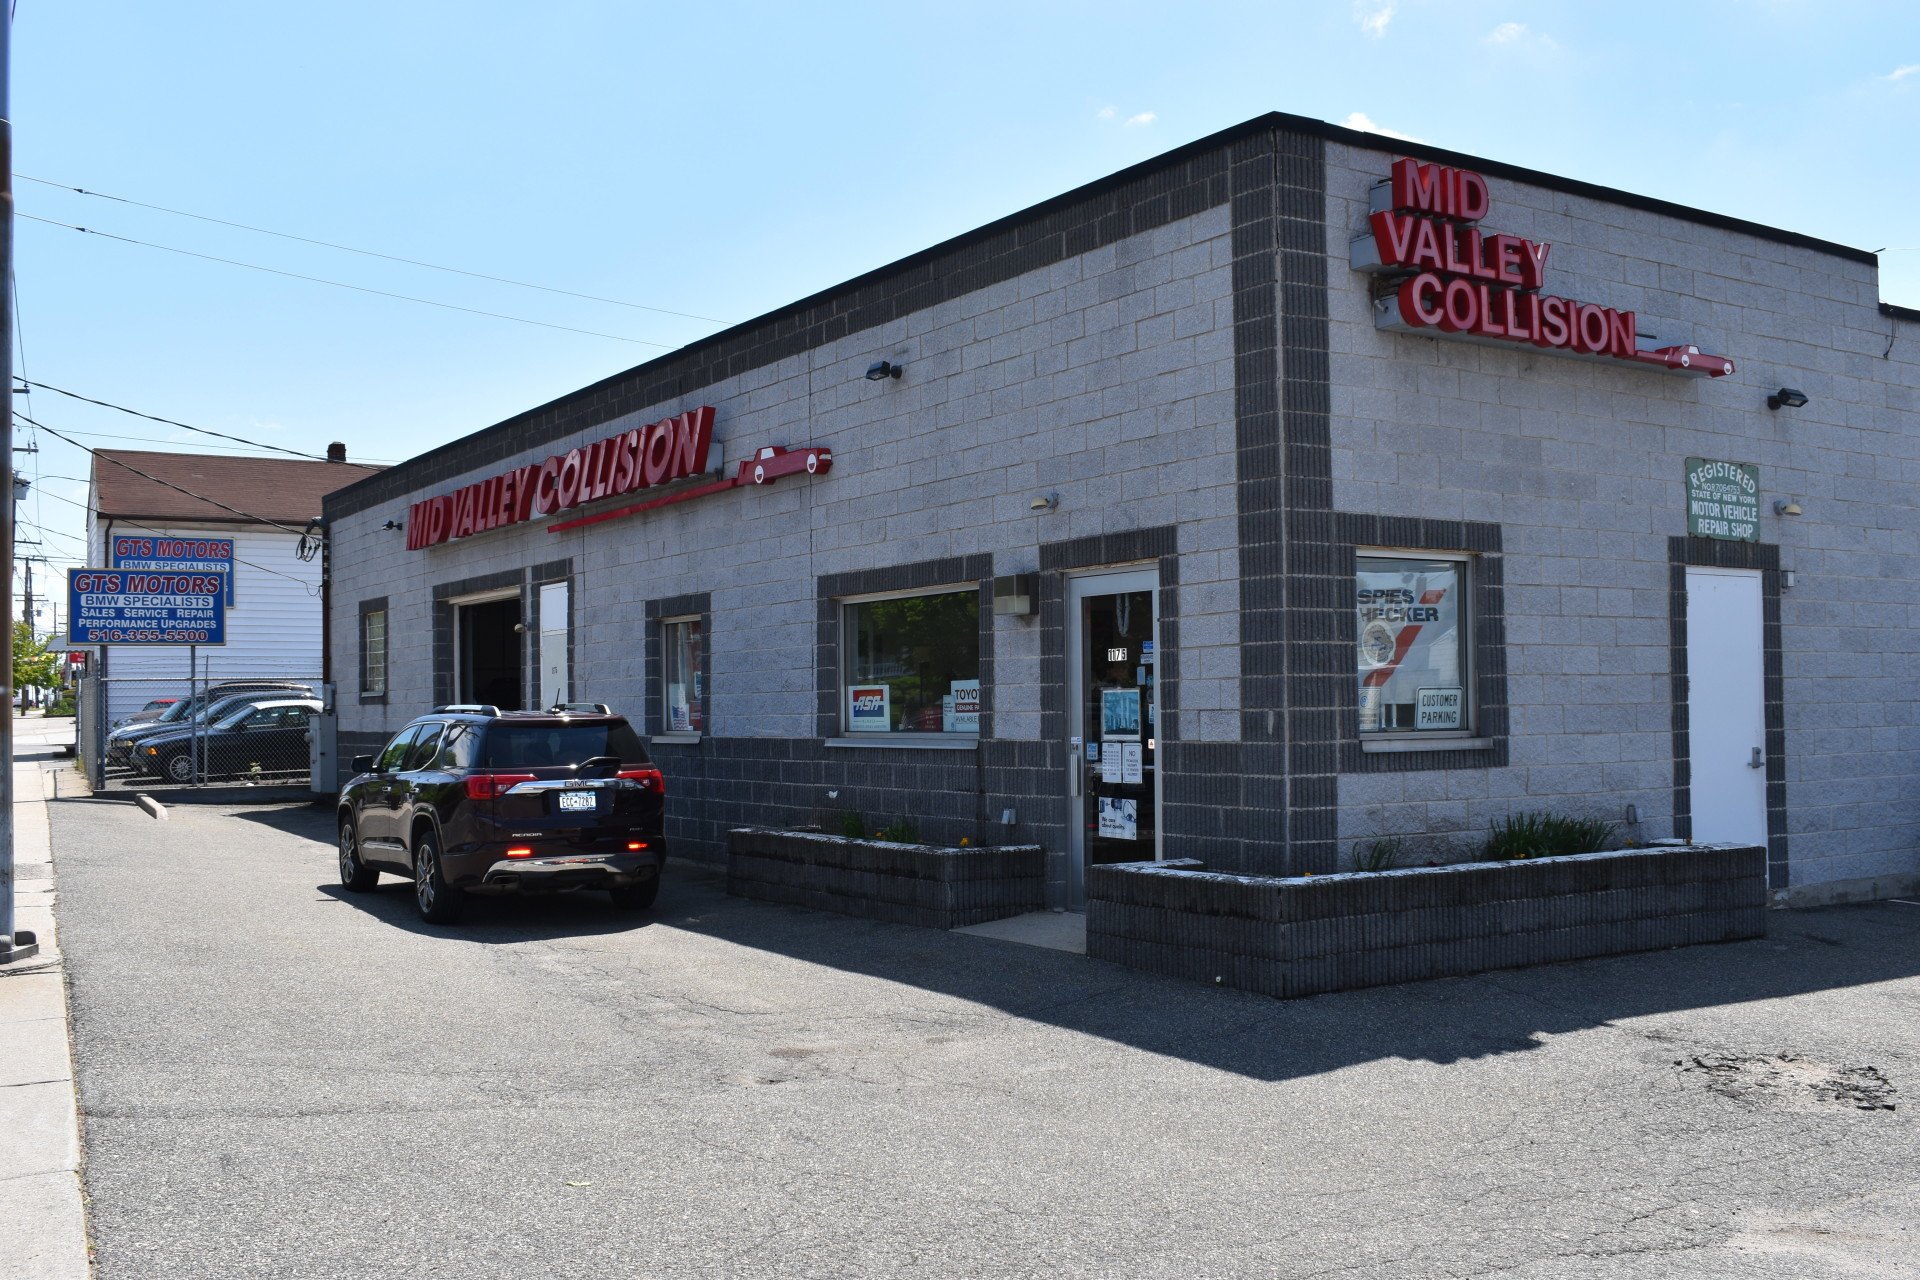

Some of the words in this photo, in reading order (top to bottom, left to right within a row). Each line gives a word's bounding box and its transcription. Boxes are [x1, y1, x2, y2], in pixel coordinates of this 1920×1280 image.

[1392, 157, 1489, 222] MID
[1369, 210, 1550, 289] VALLEY
[1398, 272, 1635, 357] COLLISION
[406, 495, 452, 550] MID
[450, 464, 540, 538] VALLEY
[535, 406, 716, 514] COLLISION
[1690, 462, 1756, 493] REGISTERED
[1691, 489, 1711, 499] STATE
[1713, 492, 1721, 500] OF
[1723, 493, 1737, 502] NEW
[1739, 495, 1756, 504] YORK
[1692, 500, 1720, 518] MOTOR
[1722, 504, 1758, 522] VEHICLE
[1698, 518, 1729, 535] REPAIR
[1731, 522, 1753, 538] SHOP
[116, 539, 152, 557] GTS
[157, 540, 231, 559] MOTORS
[123, 561, 150, 570] BMW
[154, 562, 227, 571] SPECIALISTS
[75, 574, 121, 593] GTS
[127, 575, 220, 594] MOTORS
[85, 596, 119, 606] BMW
[124, 596, 210, 607] SPECIALISTS
[1357, 589, 1414, 604] SPIES
[81, 608, 115, 617] SALES
[124, 608, 168, 618] SERVICE
[177, 608, 214, 618] REPAIR
[1360, 607, 1439, 622] HECKER
[78, 619, 158, 629] PERFORMANCE
[160, 619, 216, 629] UPGRADES
[88, 630, 208, 641] 516-355-5500
[1108, 648, 1127, 661] 1175
[1422, 694, 1458, 707] CUSTOMER
[1421, 711, 1457, 724] PARKING
